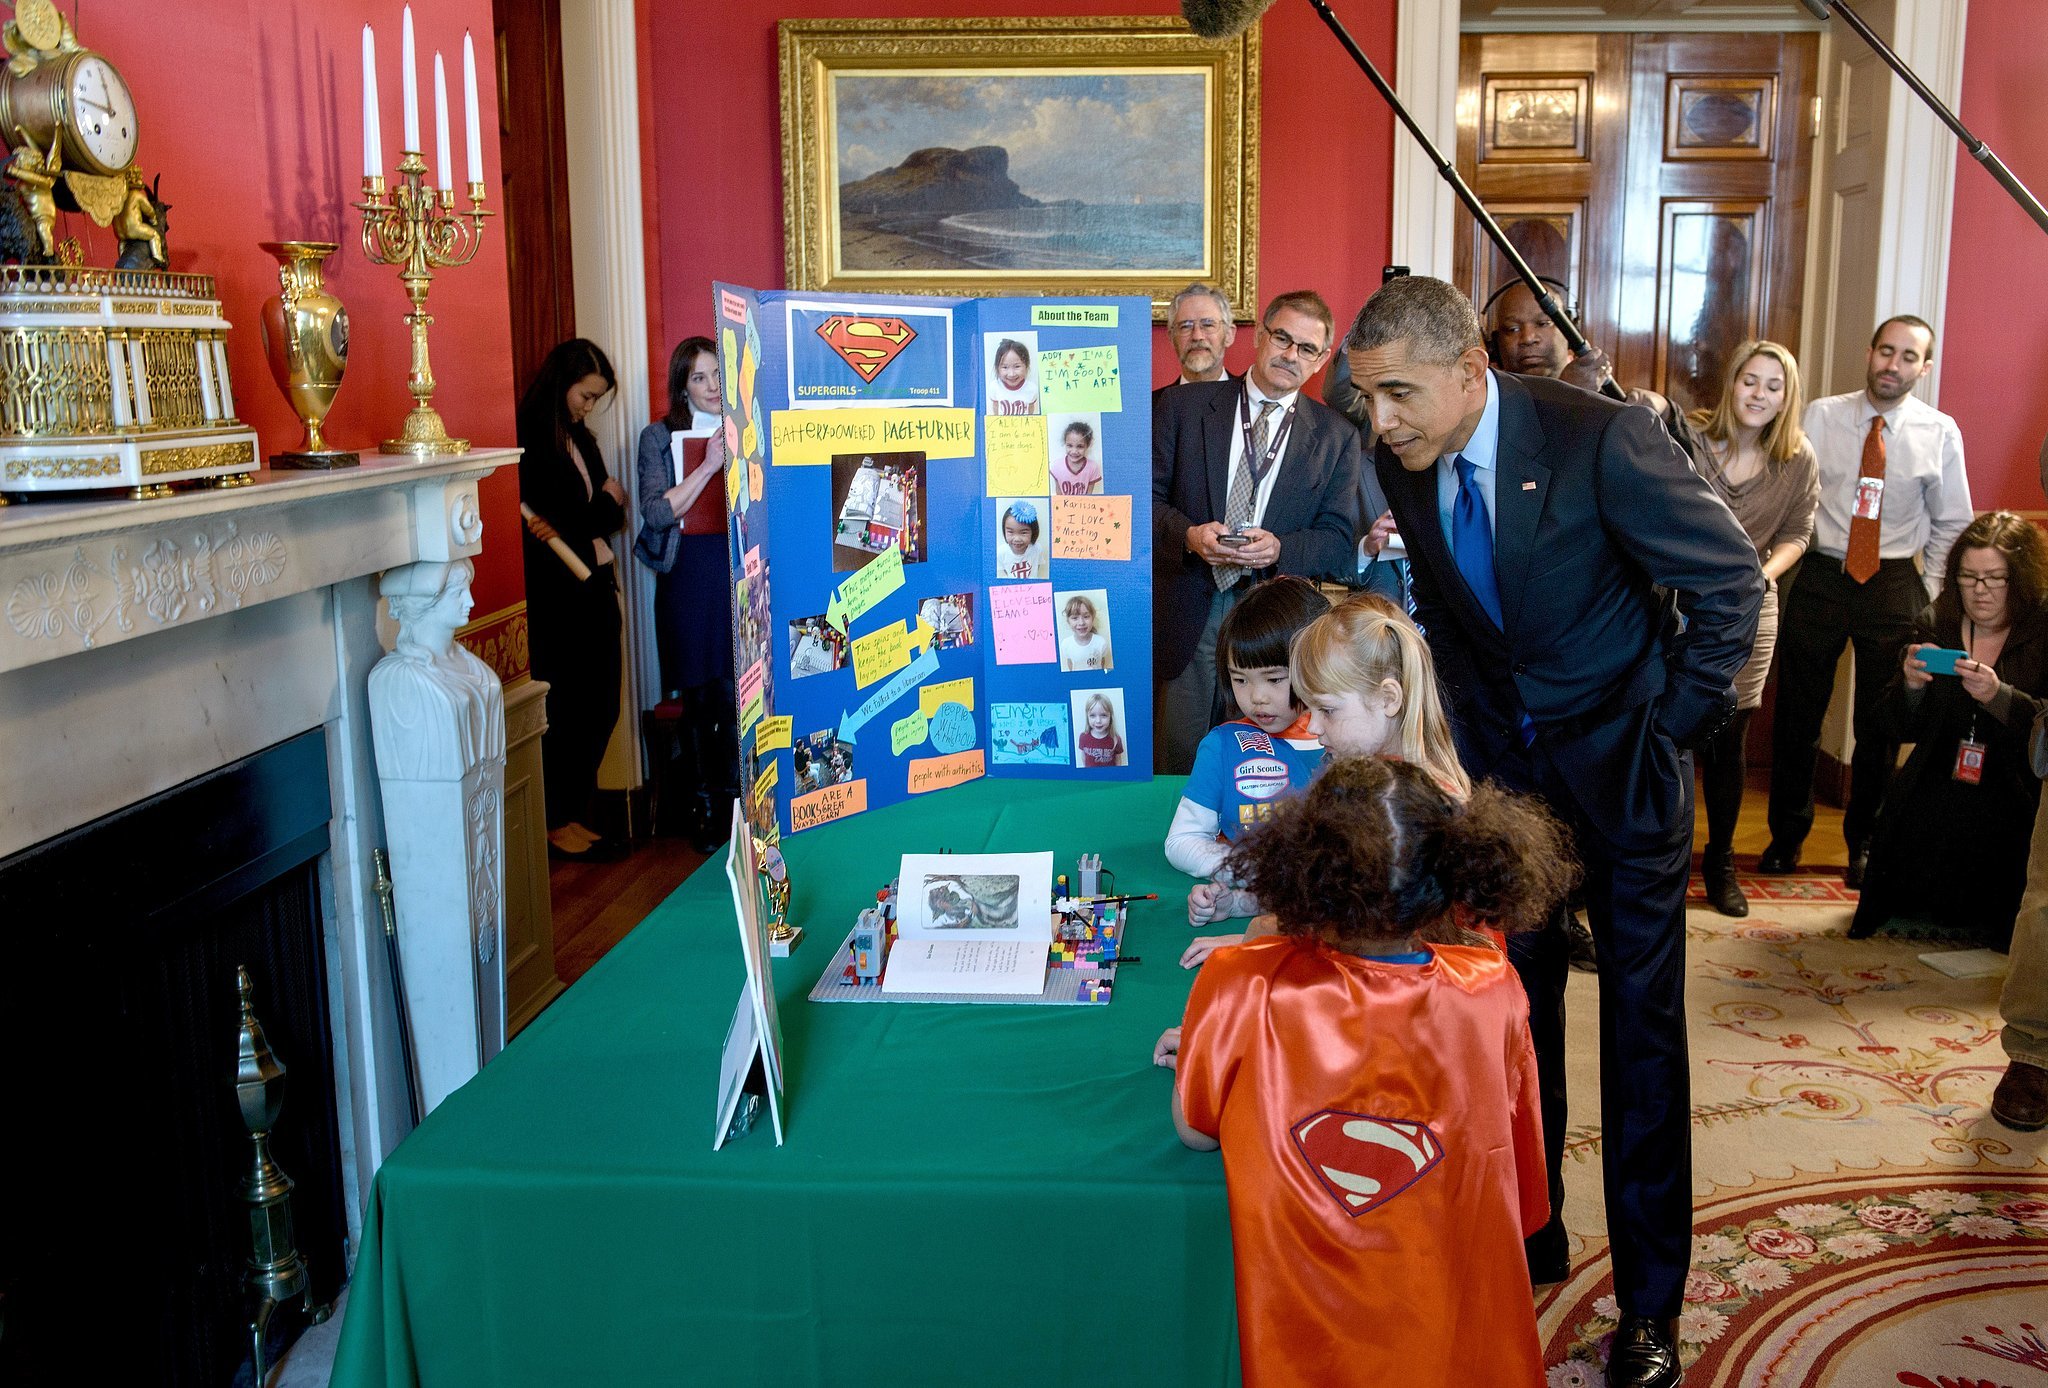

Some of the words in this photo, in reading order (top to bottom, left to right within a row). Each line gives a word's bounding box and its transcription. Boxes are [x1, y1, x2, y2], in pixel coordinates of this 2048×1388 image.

[1038, 310, 1065, 321] About
[1067, 311, 1082, 321] the
[1084, 311, 1109, 321] Team
[1041, 351, 1062, 362] ADDY
[1045, 368, 1070, 381] I'M
[1065, 380, 1080, 390] AT
[1093, 377, 1116, 388] ART
[909, 387, 928, 396] Troop
[929, 387, 940, 395] 411
[1063, 499, 1097, 510] Karissa
[1067, 513, 1076, 525] I
[1062, 526, 1099, 541] Meeting
[842, 582, 858, 598] This
[991, 585, 1033, 596] EMILY
[1003, 596, 1032, 609] LOVE
[1005, 609, 1021, 619] AM
[1022, 607, 1029, 617] 6
[855, 641, 871, 656] This
[913, 767, 933, 790] people
[934, 763, 951, 779] with
[1239, 765, 1255, 775] Girl
[792, 802, 822, 826] BOOKS
[821, 789, 842, 805] ARE
[846, 785, 853, 799] A
[822, 800, 845, 814] GREAT
[816, 809, 840, 824] LEARN
